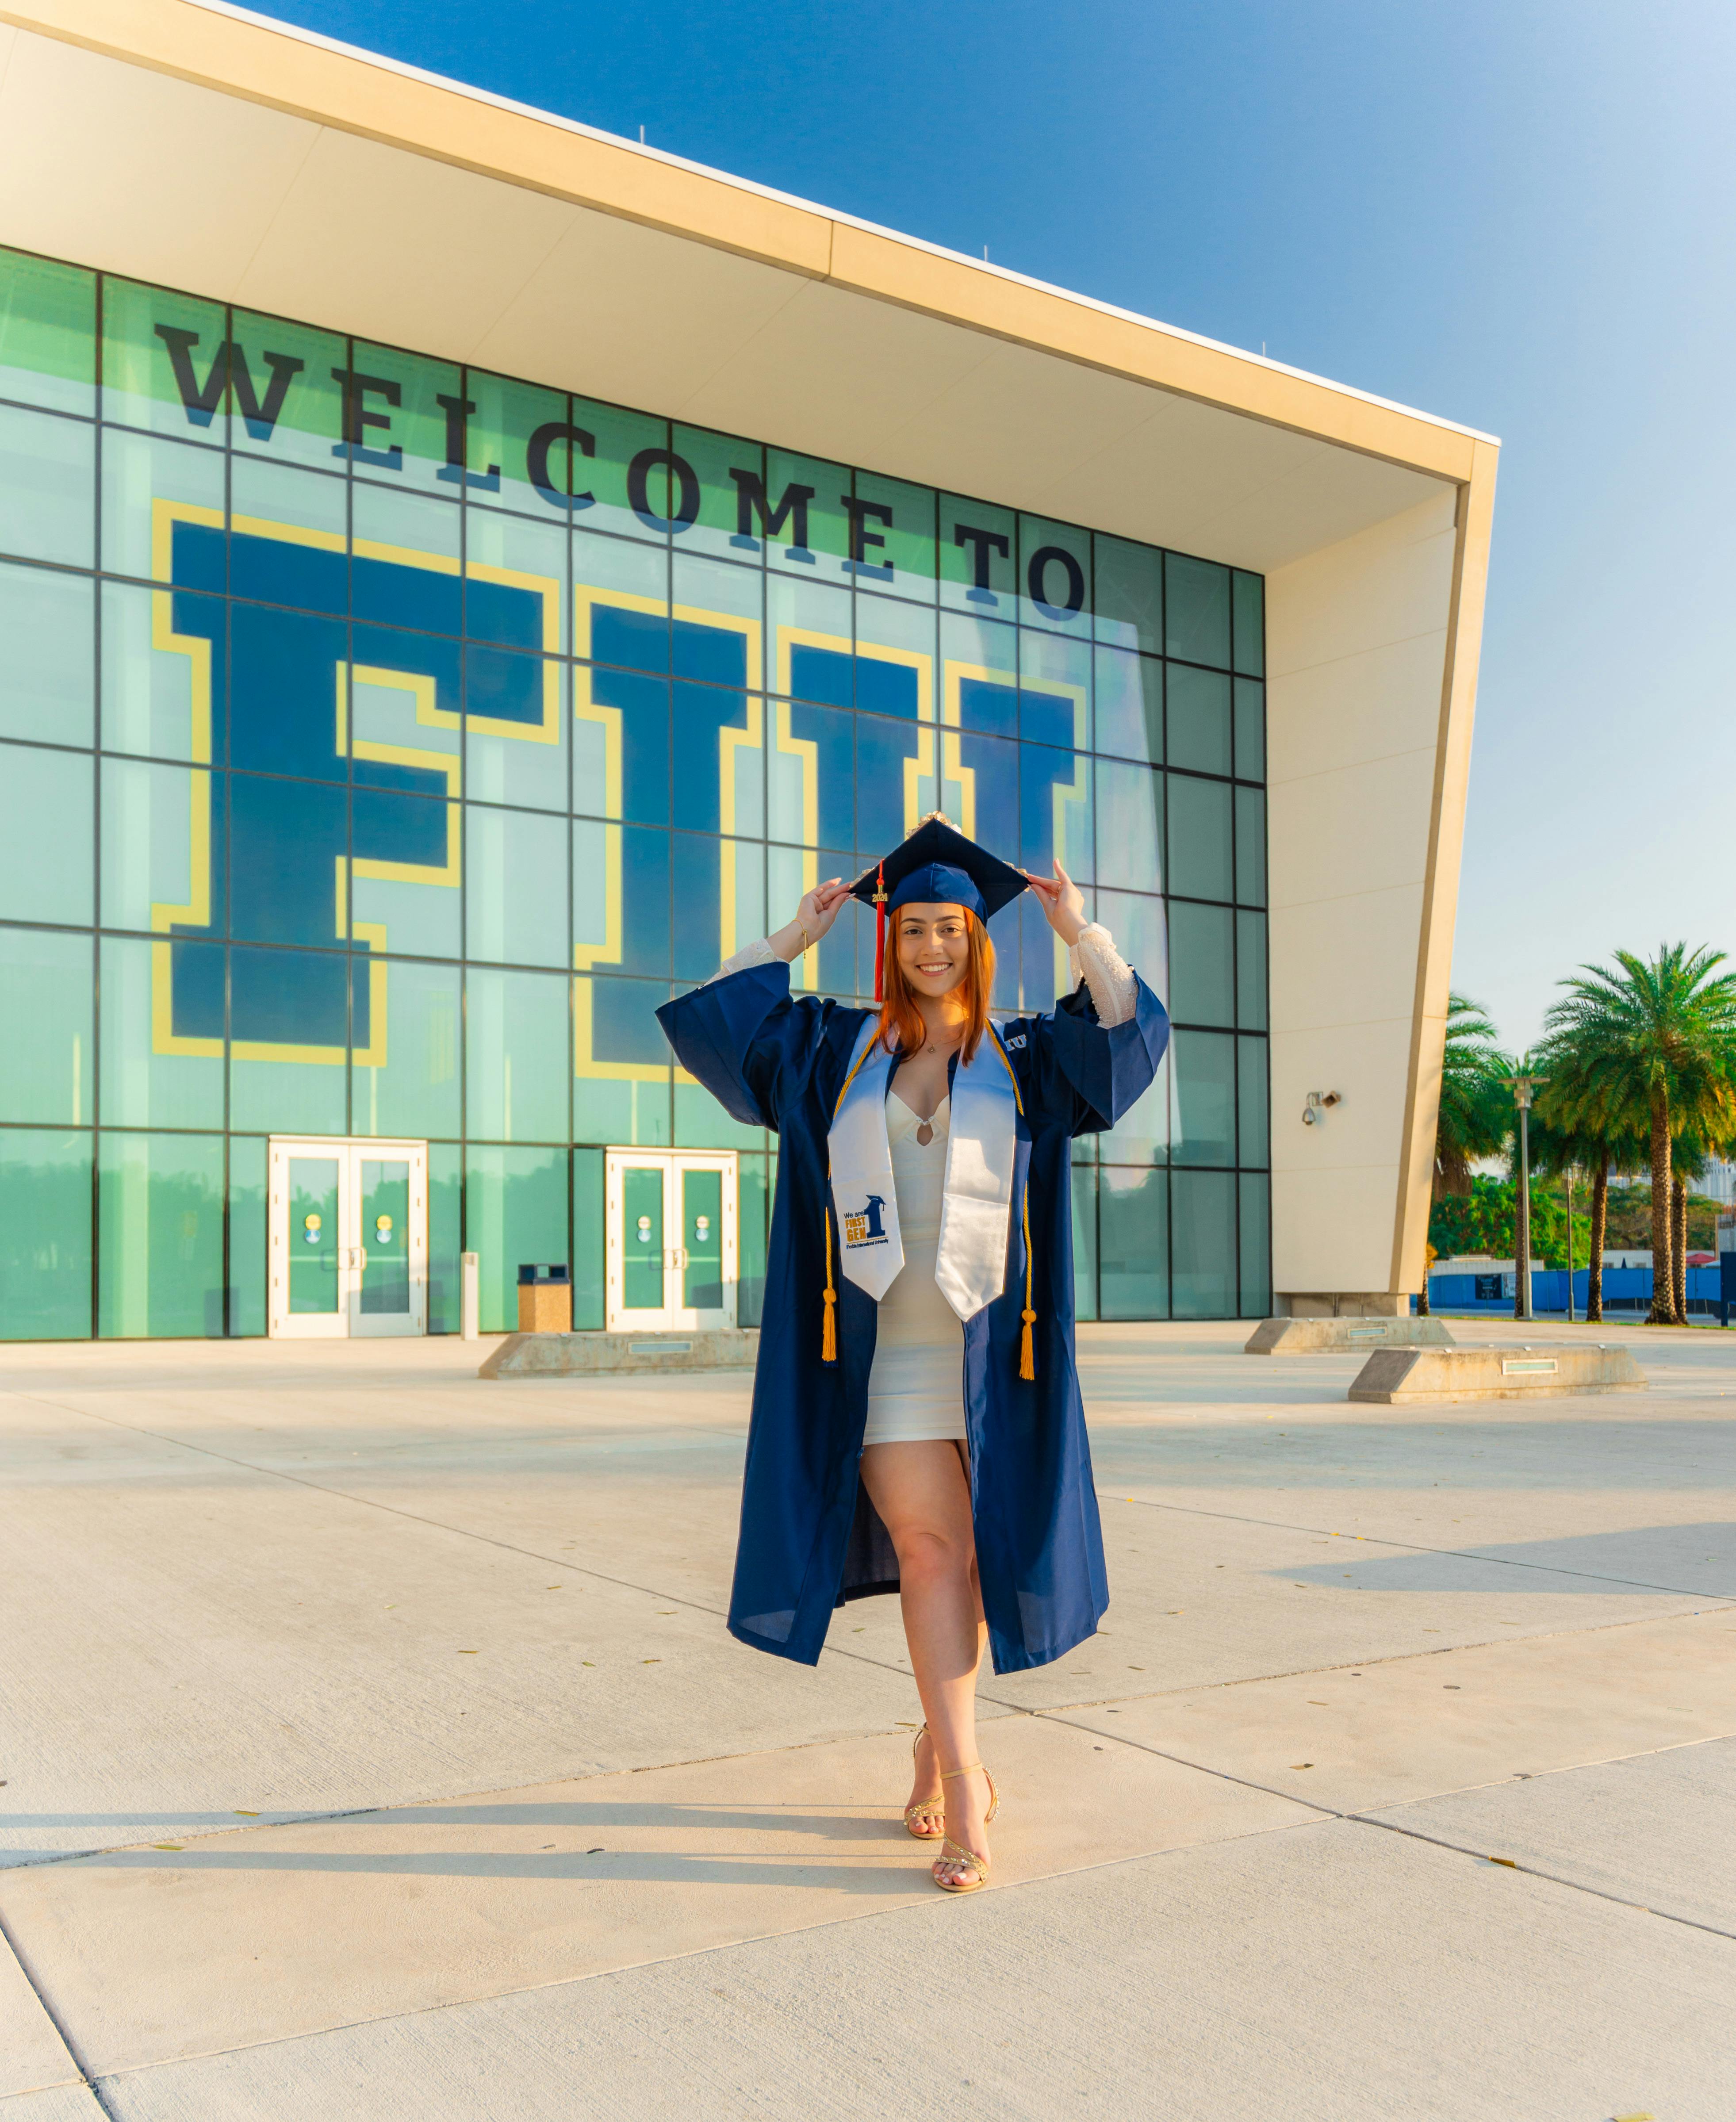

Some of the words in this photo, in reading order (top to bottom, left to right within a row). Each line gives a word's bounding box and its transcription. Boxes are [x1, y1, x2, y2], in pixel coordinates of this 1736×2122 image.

[154, 323, 893, 582] WELCOME
[954, 524, 1085, 621] TO
[152, 497, 1087, 1083] FIU
[872, 892, 889, 903] 2024
[845, 1217, 865, 1229] FIRST
[847, 1227, 866, 1242] GEN
